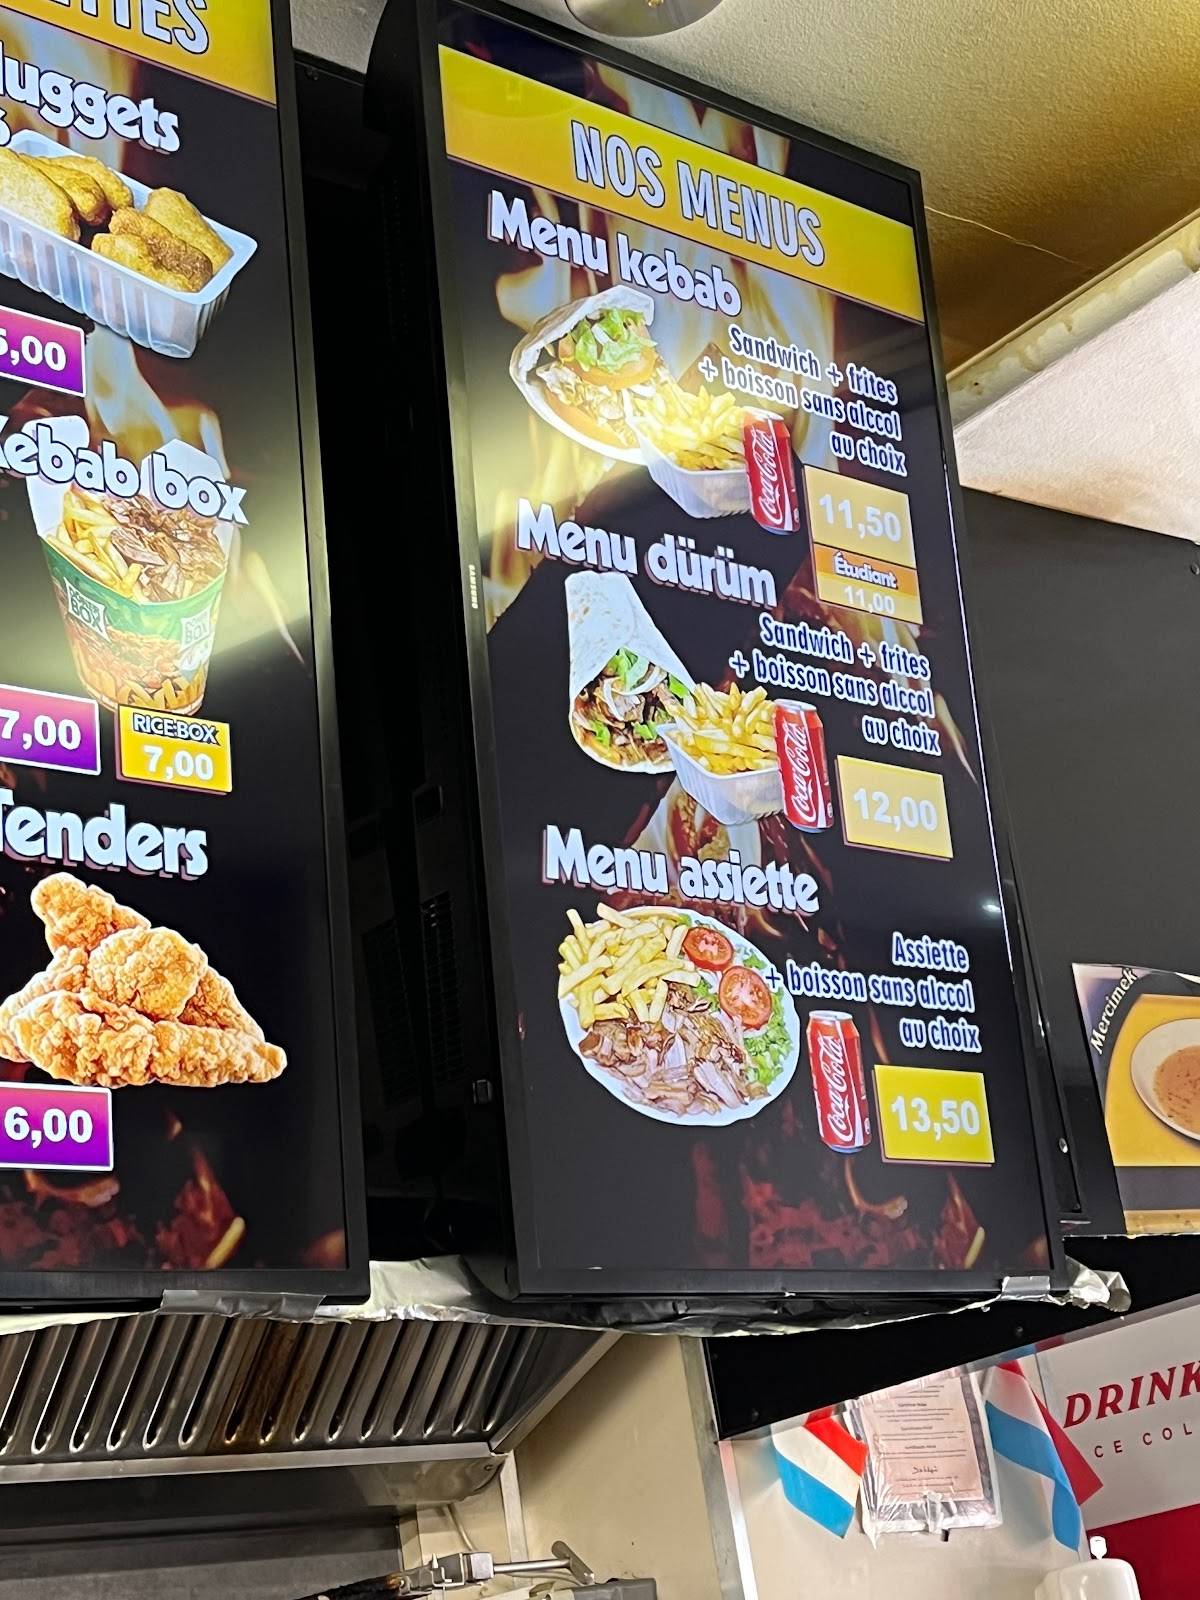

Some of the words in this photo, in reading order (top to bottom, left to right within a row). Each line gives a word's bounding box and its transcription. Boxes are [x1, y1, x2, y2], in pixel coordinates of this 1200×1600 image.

[0, 40, 181, 153] uggets
[571, 119, 666, 208] NOS
[677, 160, 826, 266] MENUS
[489, 190, 609, 276] Menu
[618, 234, 742, 316] kebab
[730, 325, 820, 379] Sandwich
[848, 364, 897, 404] frites
[723, 358, 797, 407] boisson
[802, 389, 844, 422] sans
[831, 432, 854, 460] au
[858, 438, 906, 475] choix
[153, 452, 249, 525] box
[819, 494, 902, 541] 11,50
[515, 498, 637, 575] Menu
[645, 534, 777, 608] dürüm
[834, 551, 898, 589] Étudiant
[844, 585, 895, 614] 11,00
[760, 613, 853, 663] Sandwich
[880, 642, 929, 680] frites
[753, 649, 830, 695] boisson
[833, 673, 877, 705] sans
[0, 708, 81, 750] 7,00
[863, 716, 887, 744] au
[891, 718, 940, 755] choix
[143, 744, 213, 780] 7,00
[854, 787, 938, 831] 12,00
[543, 825, 668, 895] Menu
[680, 851, 820, 914] assiette
[893, 932, 968, 973] Assiette
[787, 959, 866, 1001] boisson
[870, 975, 915, 1005] sans
[1089, 966, 1138, 1055] Mercimek
[901, 1018, 926, 1047] au
[929, 1017, 981, 1052] choix
[4, 1106, 93, 1148] 6,00
[890, 1096, 980, 1139] 13,50
